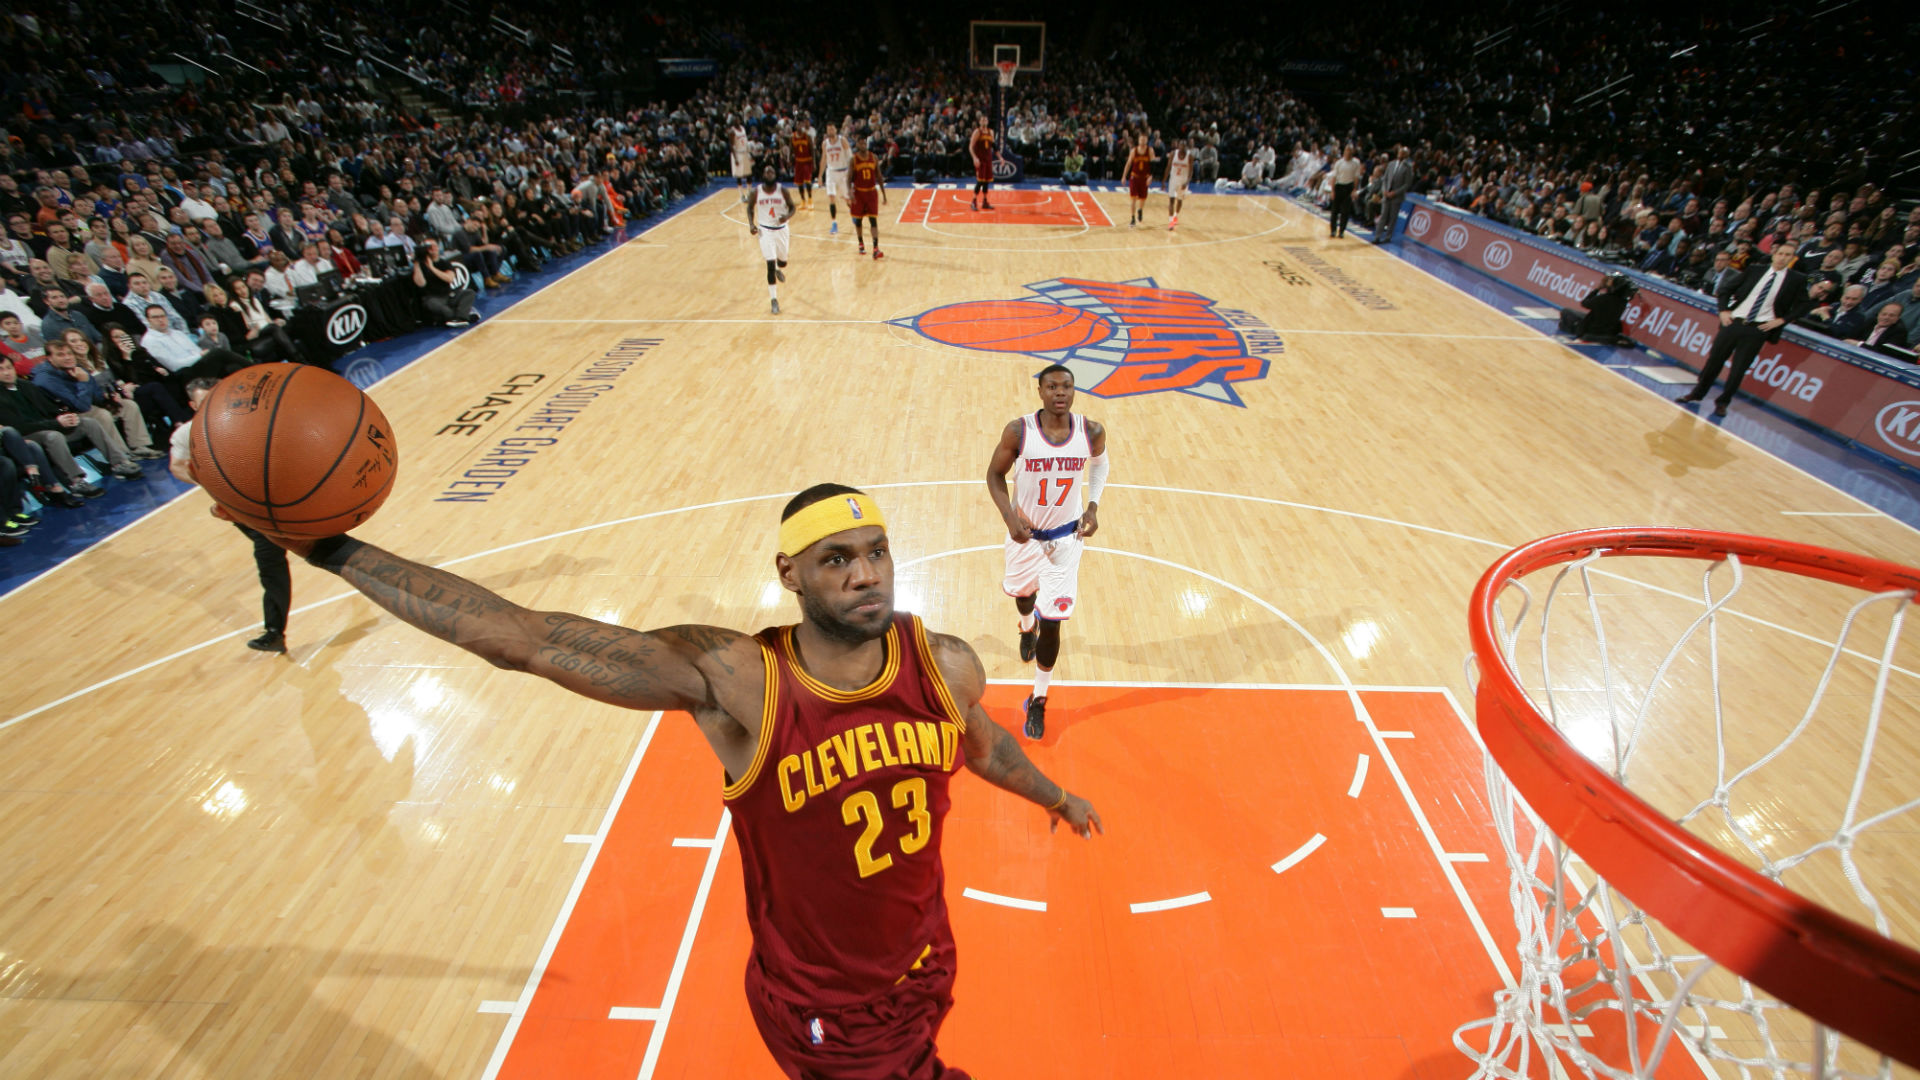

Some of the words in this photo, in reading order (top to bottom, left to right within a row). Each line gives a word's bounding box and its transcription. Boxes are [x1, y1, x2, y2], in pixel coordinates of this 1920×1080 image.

[862, 169, 871, 180] 13
[769, 206, 776, 218] 4
[1412, 214, 1428, 231] KIA
[1447, 229, 1465, 247] KIA
[1486, 246, 1507, 265] KIA
[1526, 259, 1597, 303] Introduci
[333, 310, 361, 340] KIA
[1057, 277, 1265, 398] KNICKS
[576, 338, 665, 380] MADISON
[434, 373, 546, 437] CHASE
[515, 384, 615, 432] SQUARE
[1885, 406, 1920, 446] KI
[433, 437, 559, 502] GARDEN
[1025, 458, 1057, 473] NEW
[1057, 456, 1088, 471] YORK
[1036, 477, 1074, 507] 17
[777, 721, 959, 813] CLEVELAND
[841, 777, 932, 879] 23
